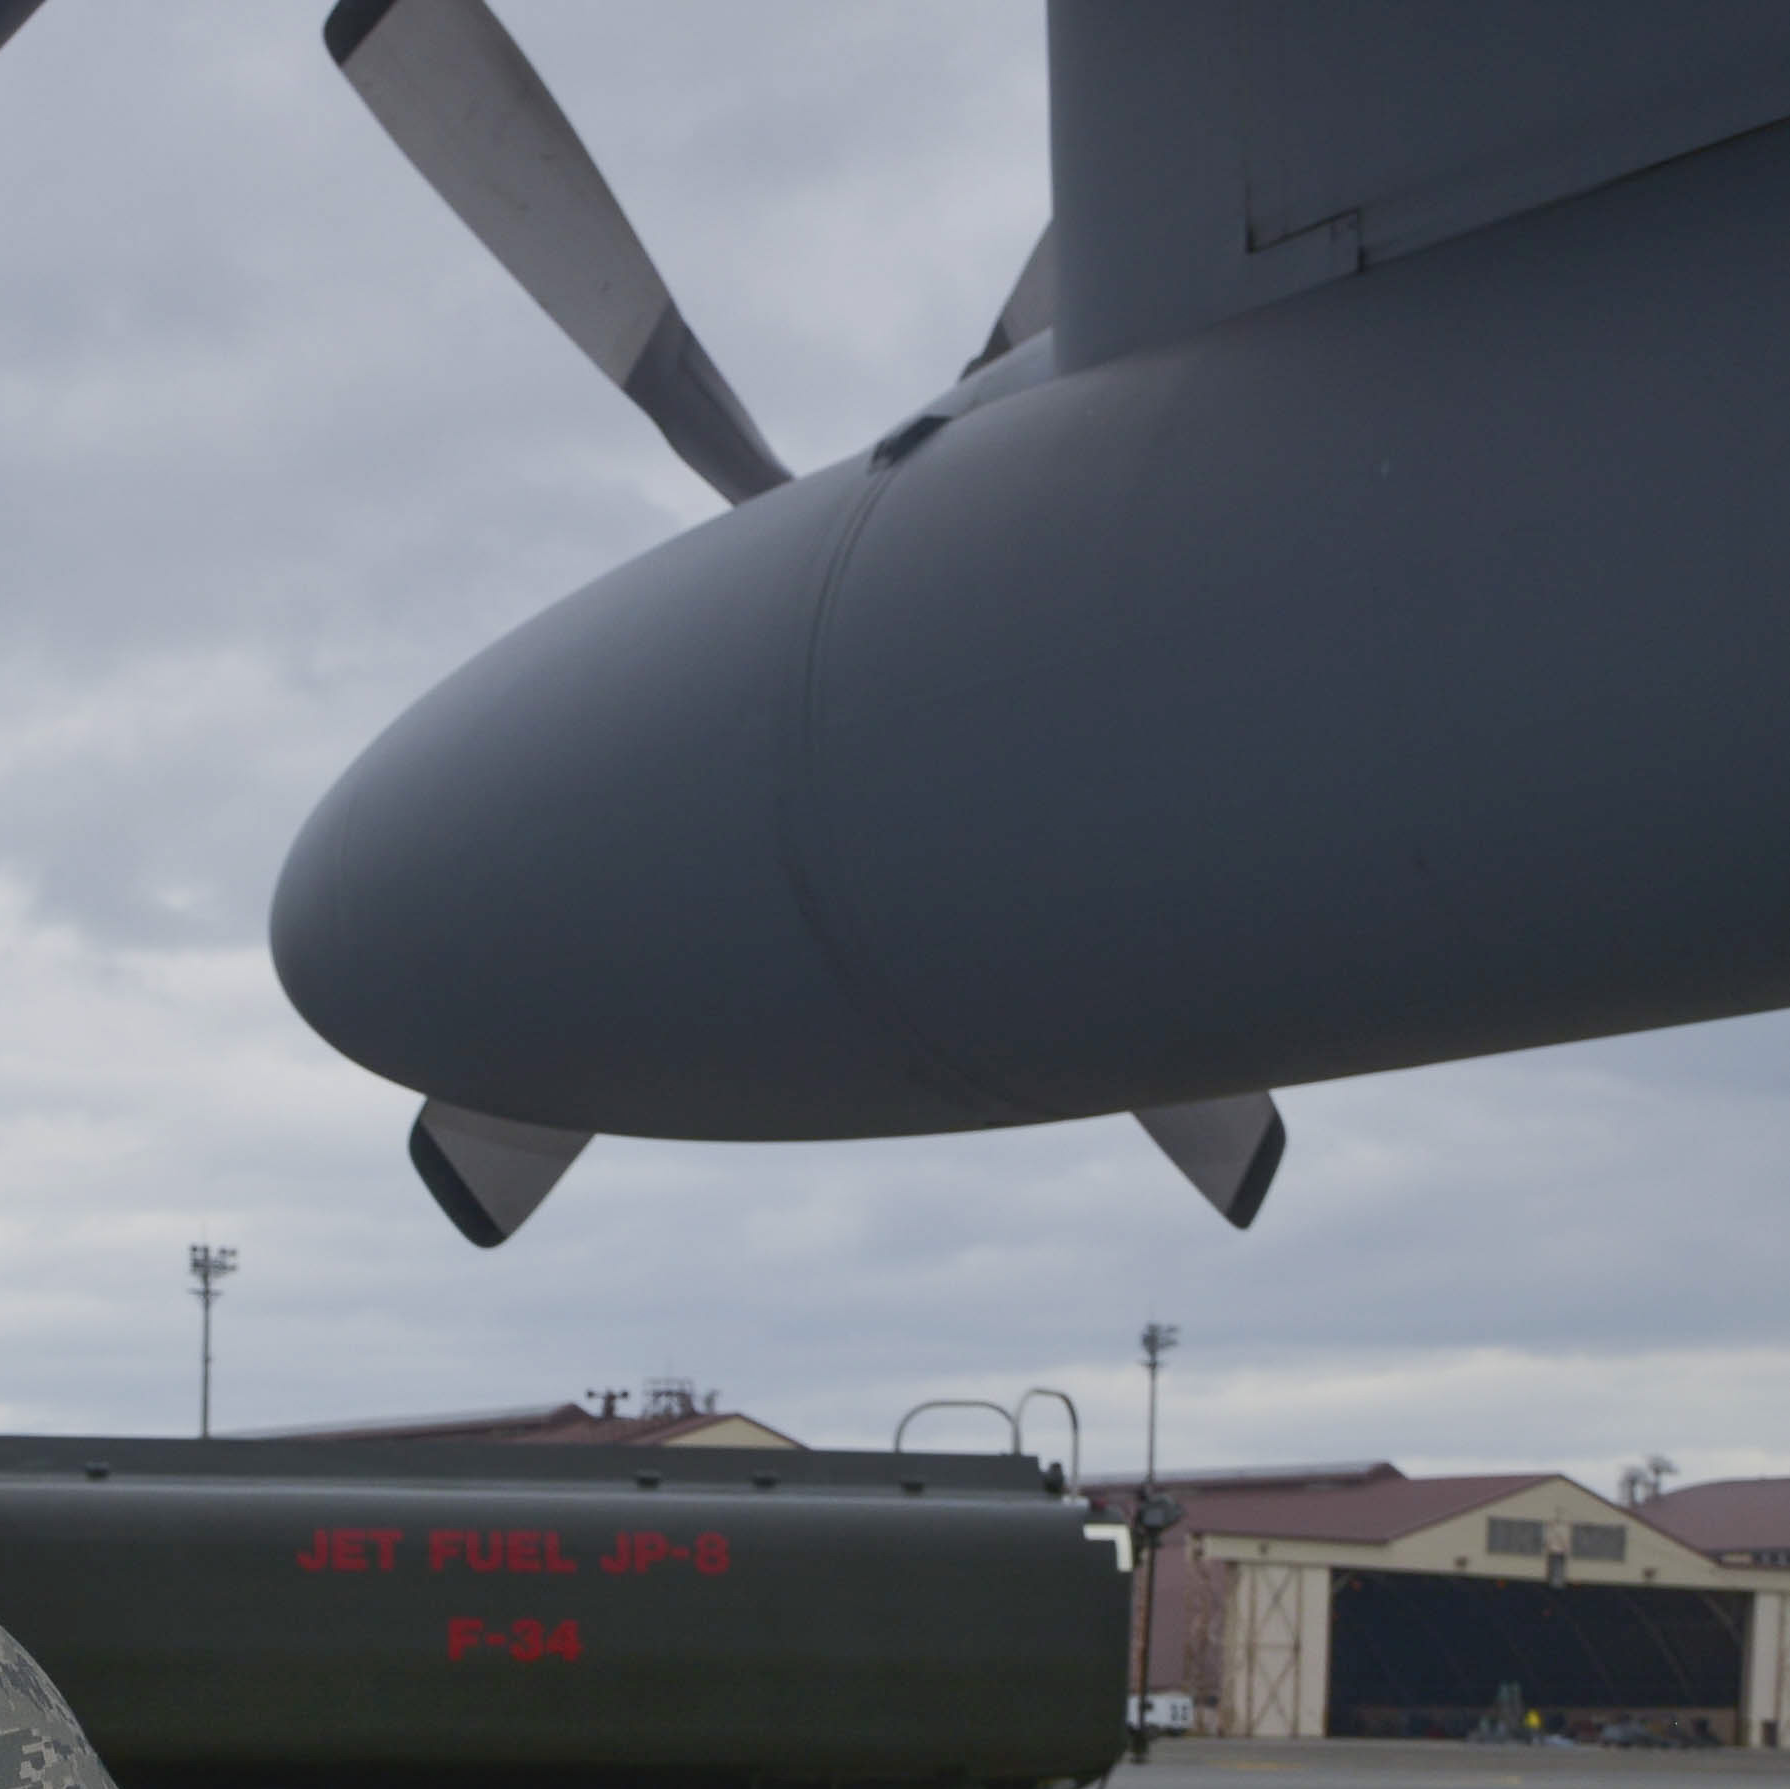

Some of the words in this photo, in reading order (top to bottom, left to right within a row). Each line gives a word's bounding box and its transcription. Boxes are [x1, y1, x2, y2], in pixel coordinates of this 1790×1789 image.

[296, 1527, 403, 1572] JET
[428, 1530, 577, 1573] FUEL
[600, 1531, 730, 1575] JP-8
[447, 1618, 583, 1662] F-34
